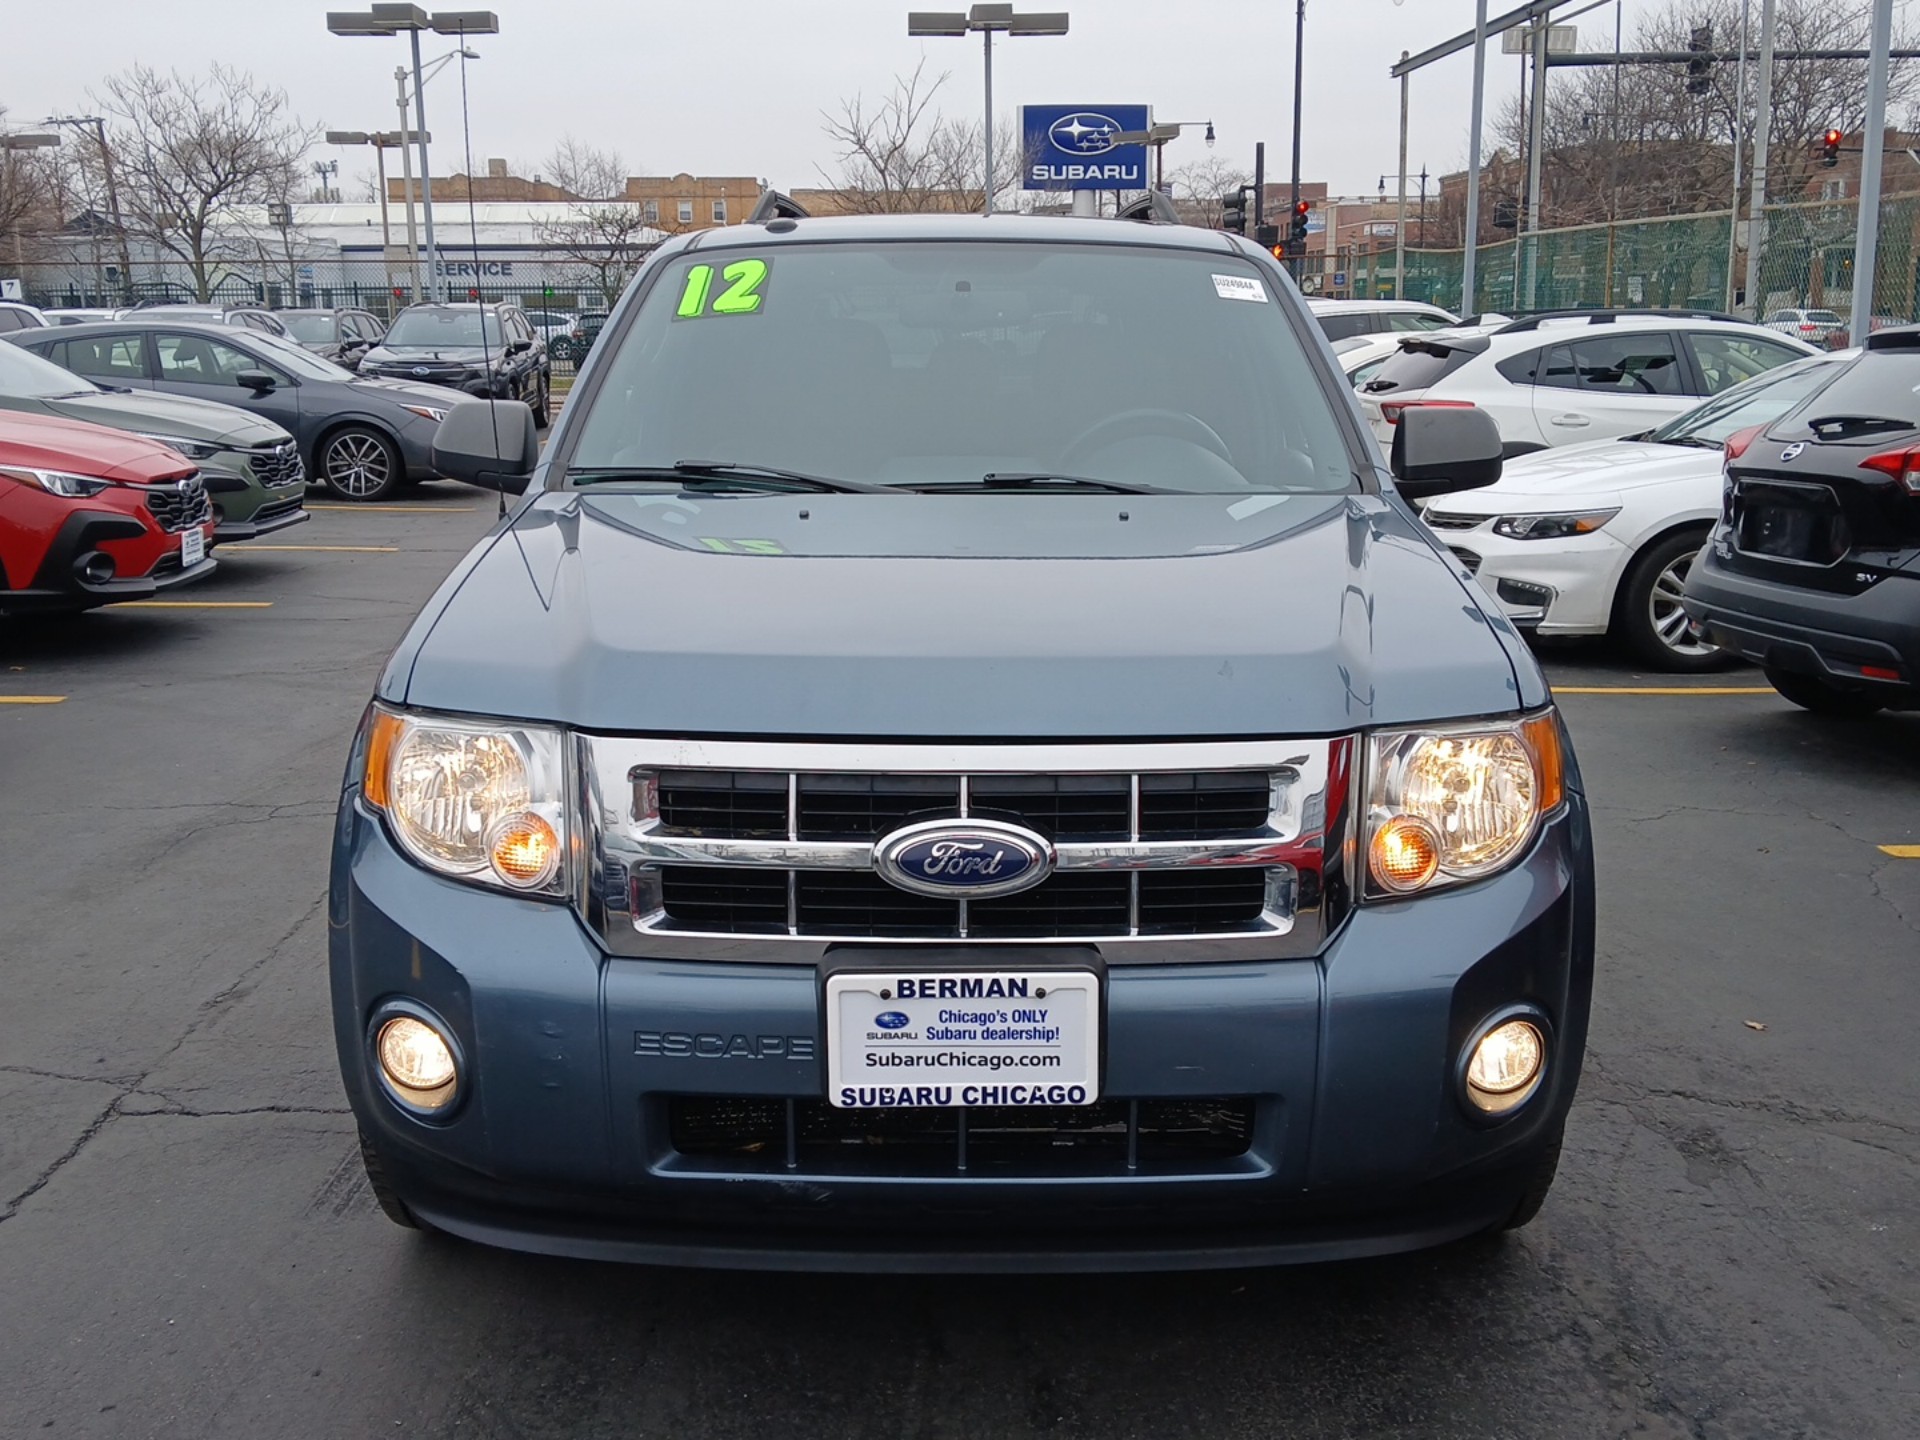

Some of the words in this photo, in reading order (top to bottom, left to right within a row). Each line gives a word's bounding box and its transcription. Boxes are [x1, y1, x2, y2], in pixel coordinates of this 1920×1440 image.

[1032, 164, 1138, 180] SUBARU
[436, 263, 513, 276] SERVICE
[677, 258, 768, 317] 12
[1856, 572, 1878, 583] SV
[923, 841, 1003, 875] Ford
[897, 978, 1028, 998] BERMAN
[939, 1009, 1008, 1026] Chicago's
[1012, 1009, 1048, 1023] ONLY
[866, 1032, 918, 1040] SUBARU
[926, 1026, 977, 1040] Subaru
[981, 1026, 1060, 1043] dealership!
[634, 1031, 814, 1060] ESCAPE
[865, 1052, 1061, 1070] SubaruChicago.com
[840, 1086, 952, 1106] SUBARU
[962, 1085, 1086, 1105] CHICAGO
